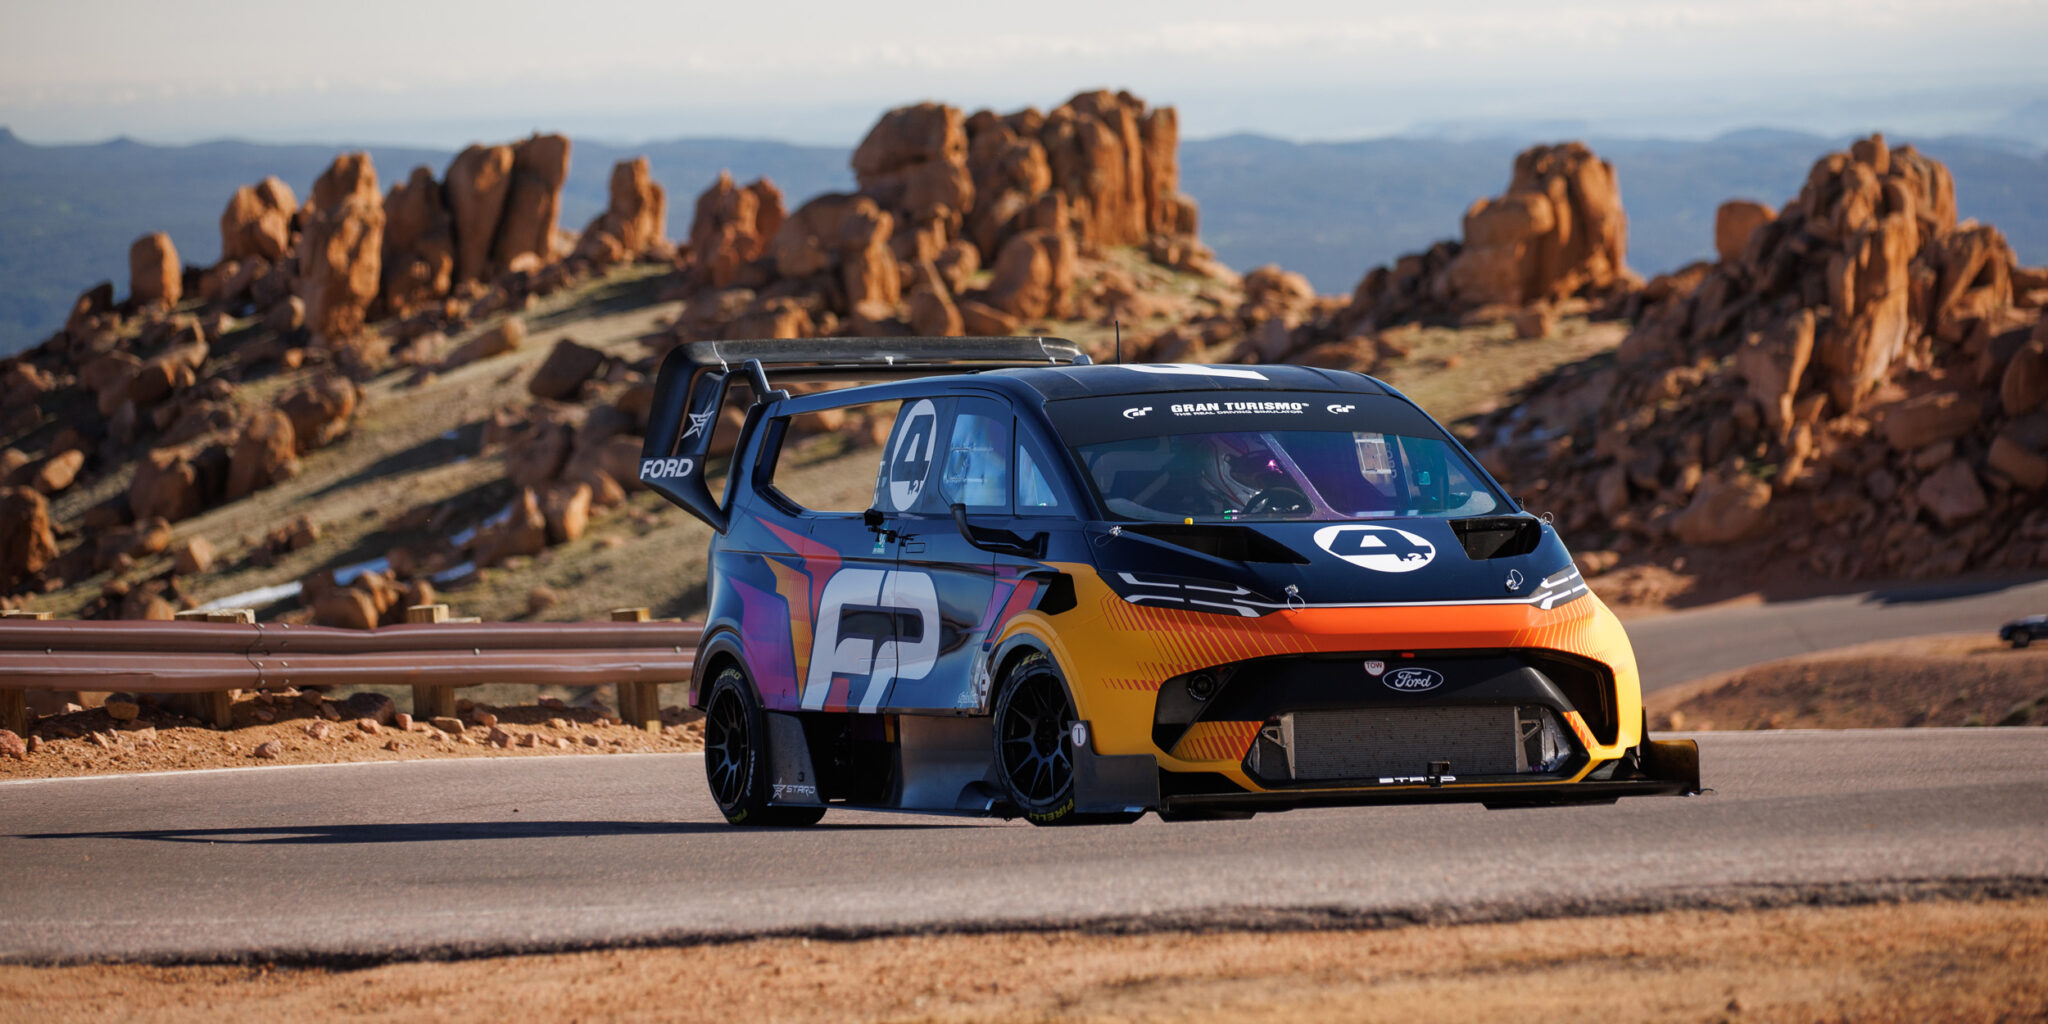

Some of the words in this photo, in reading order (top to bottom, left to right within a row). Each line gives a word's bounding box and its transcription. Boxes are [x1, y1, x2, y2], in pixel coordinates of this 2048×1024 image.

[1171, 402, 1220, 413] GRAN
[639, 458, 694, 480] FORD
[1366, 662, 1383, 670] TOW
[1394, 671, 1432, 688] Ford
[1029, 798, 1074, 822] PIRELLI
